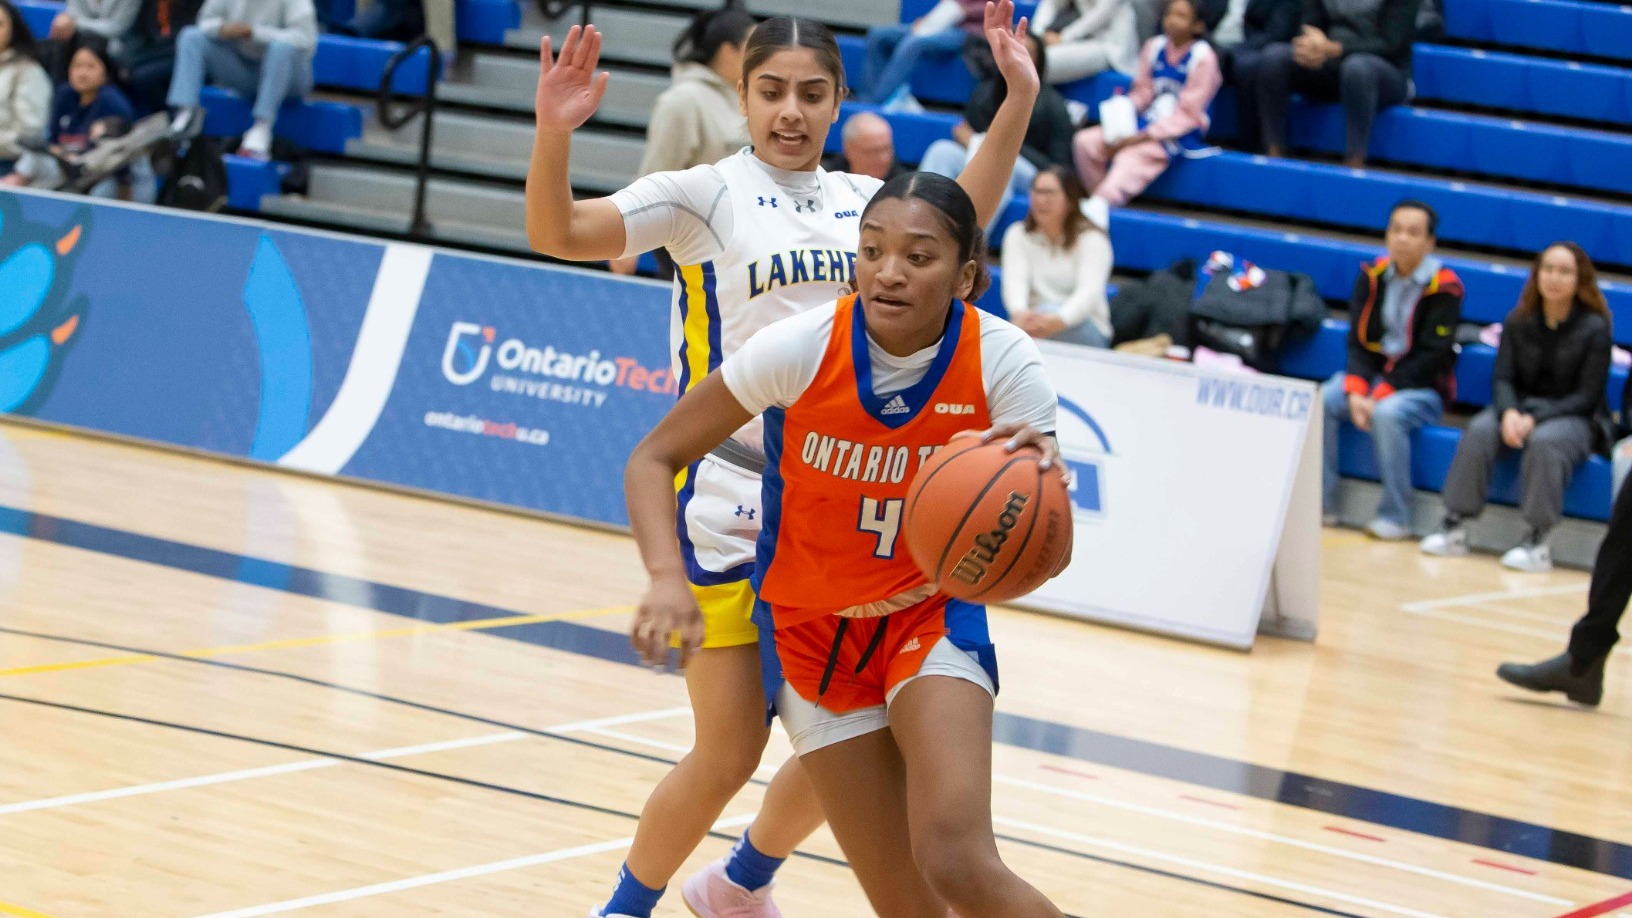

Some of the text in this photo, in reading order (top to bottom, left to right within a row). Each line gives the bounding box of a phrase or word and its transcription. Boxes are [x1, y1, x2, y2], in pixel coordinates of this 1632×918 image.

[834, 209, 859, 219] OUA
[490, 375, 608, 406] UNIVERSITY
[880, 406, 910, 415] adidas
[934, 402, 975, 414] OUA
[801, 431, 909, 484] ONTARIO
[856, 494, 906, 560] 4
[948, 489, 1031, 587] Wilson
